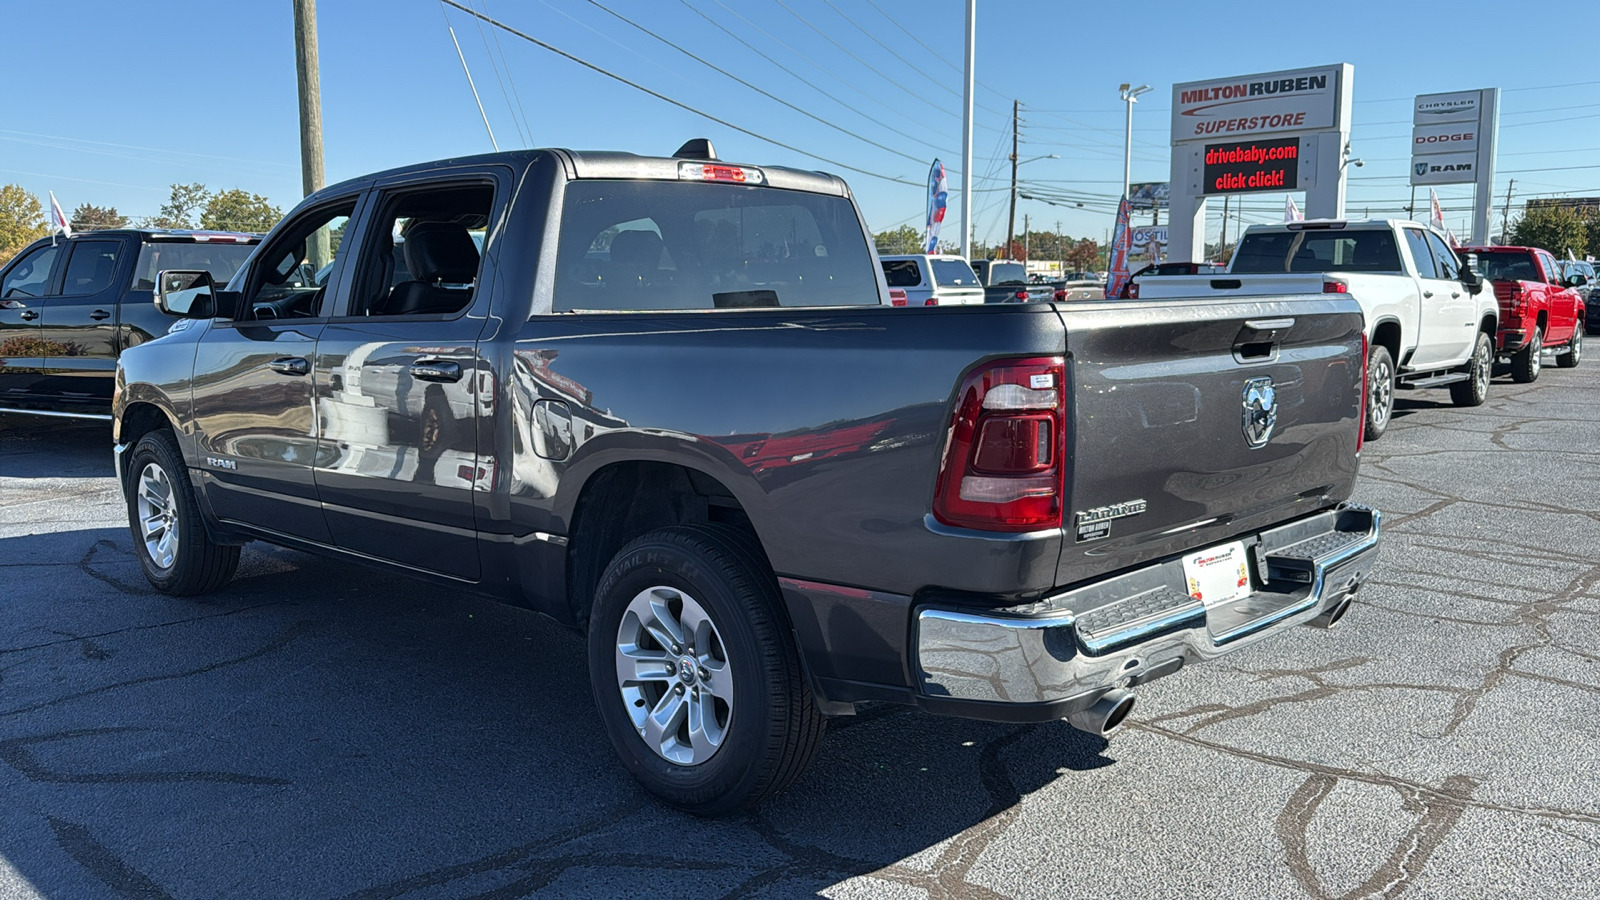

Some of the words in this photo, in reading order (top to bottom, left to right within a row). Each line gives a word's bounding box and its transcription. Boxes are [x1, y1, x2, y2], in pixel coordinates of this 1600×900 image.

[1418, 100, 1474, 109] CHRYSLER
[1194, 112, 1306, 135] SUPERSTORE
[1415, 133, 1474, 144] DODGE
[1205, 145, 1297, 165] drivebaby.com
[1430, 163, 1472, 173] RAM
[1215, 171, 1246, 190] click
[1248, 169, 1284, 188] click!
[207, 457, 238, 470] RAM
[1076, 498, 1147, 524] LARAMIE
